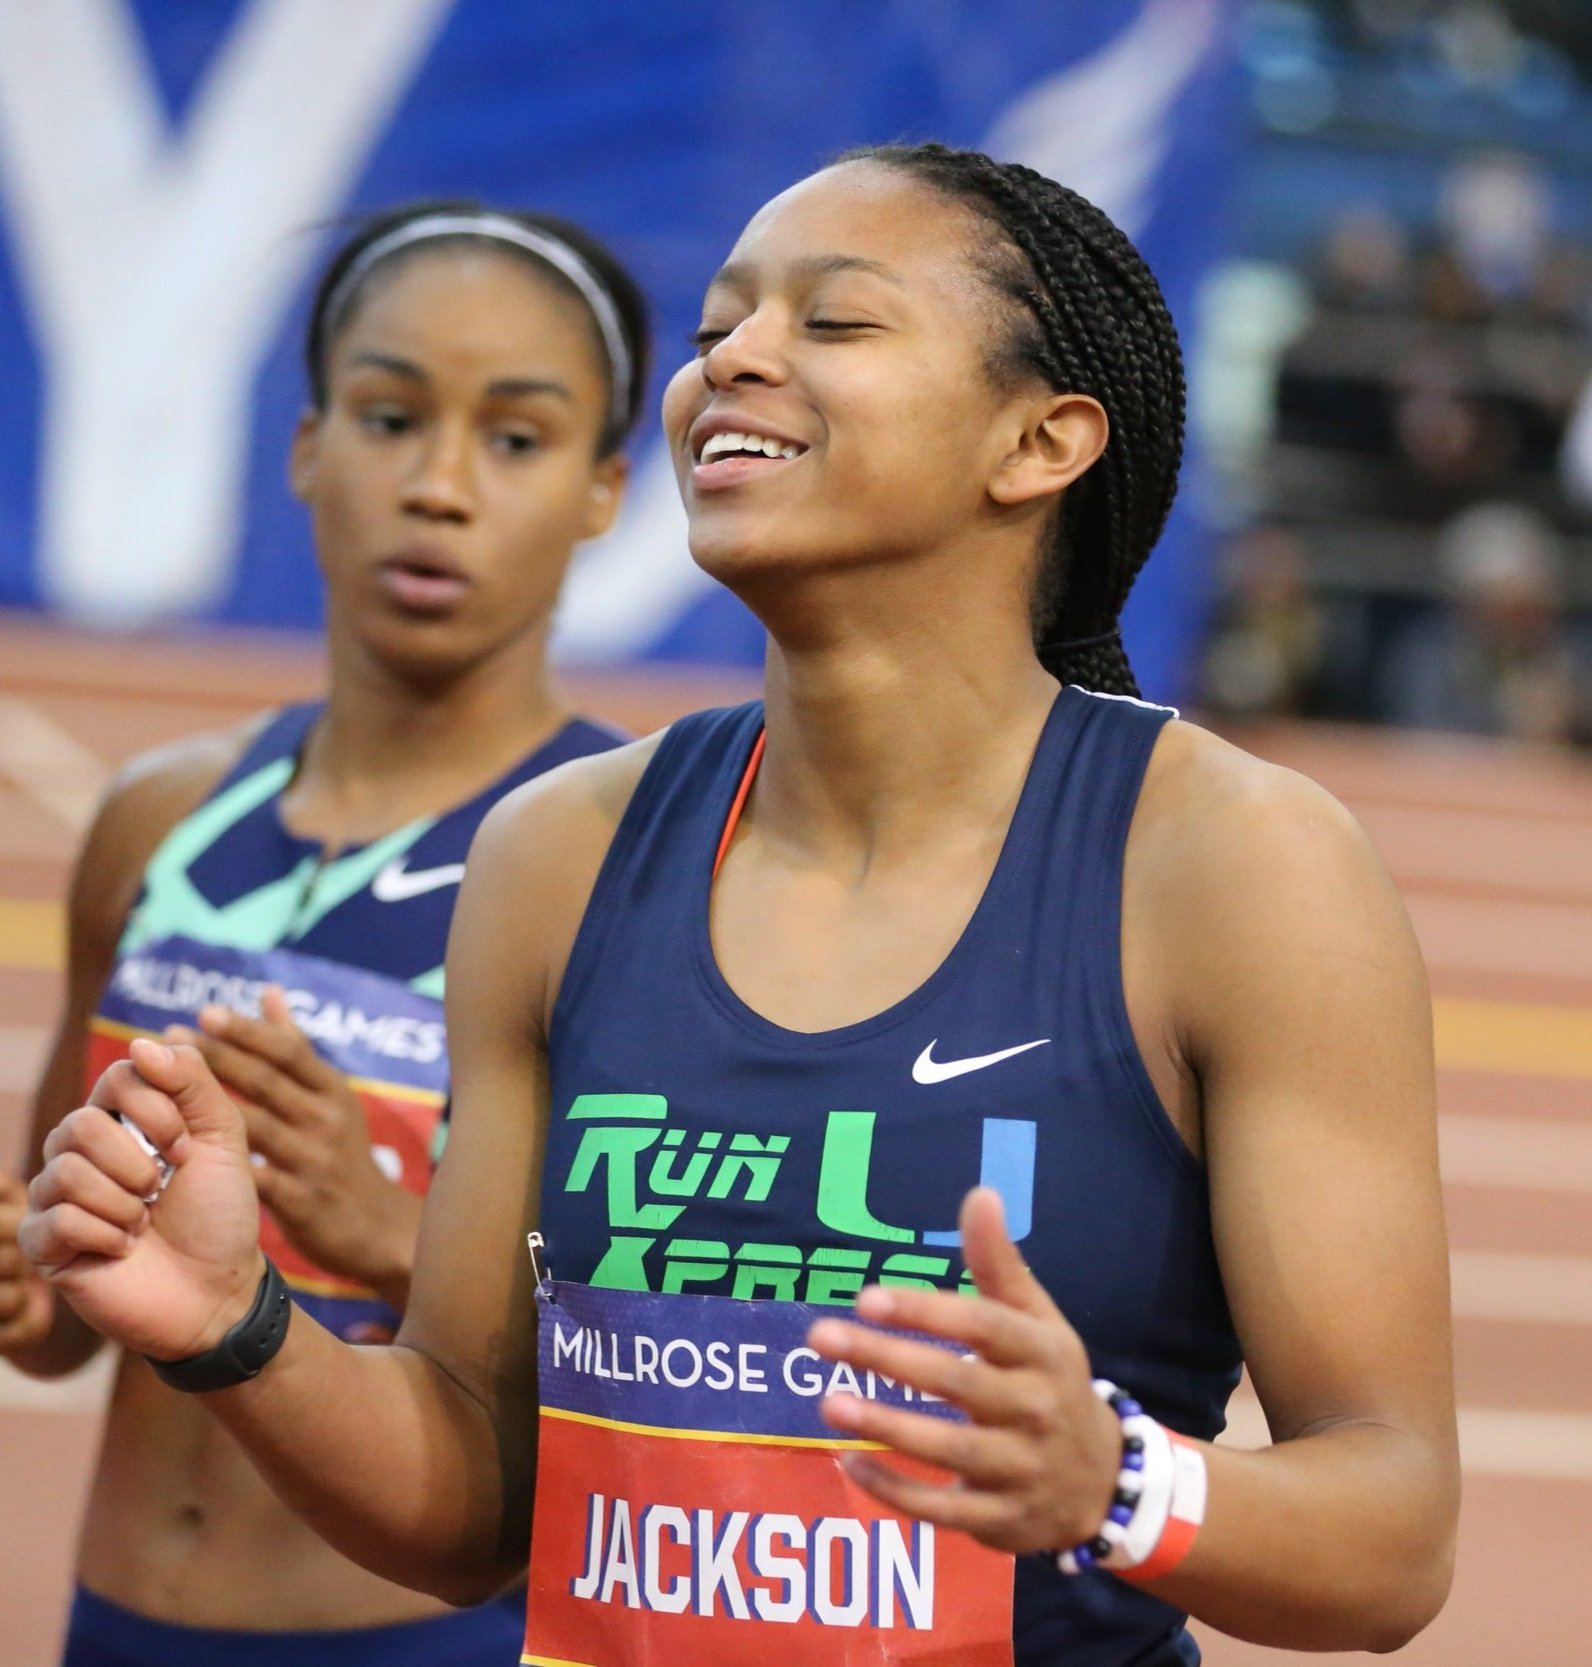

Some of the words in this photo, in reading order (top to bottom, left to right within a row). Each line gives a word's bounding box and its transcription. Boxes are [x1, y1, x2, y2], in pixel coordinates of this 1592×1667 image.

[284, 989, 447, 1063] GAMES
[589, 1236, 1032, 1305] XPRES
[552, 1322, 769, 1393] MILLROSE
[782, 1346, 978, 1402] GAM
[570, 1493, 936, 1632] JACKSON
